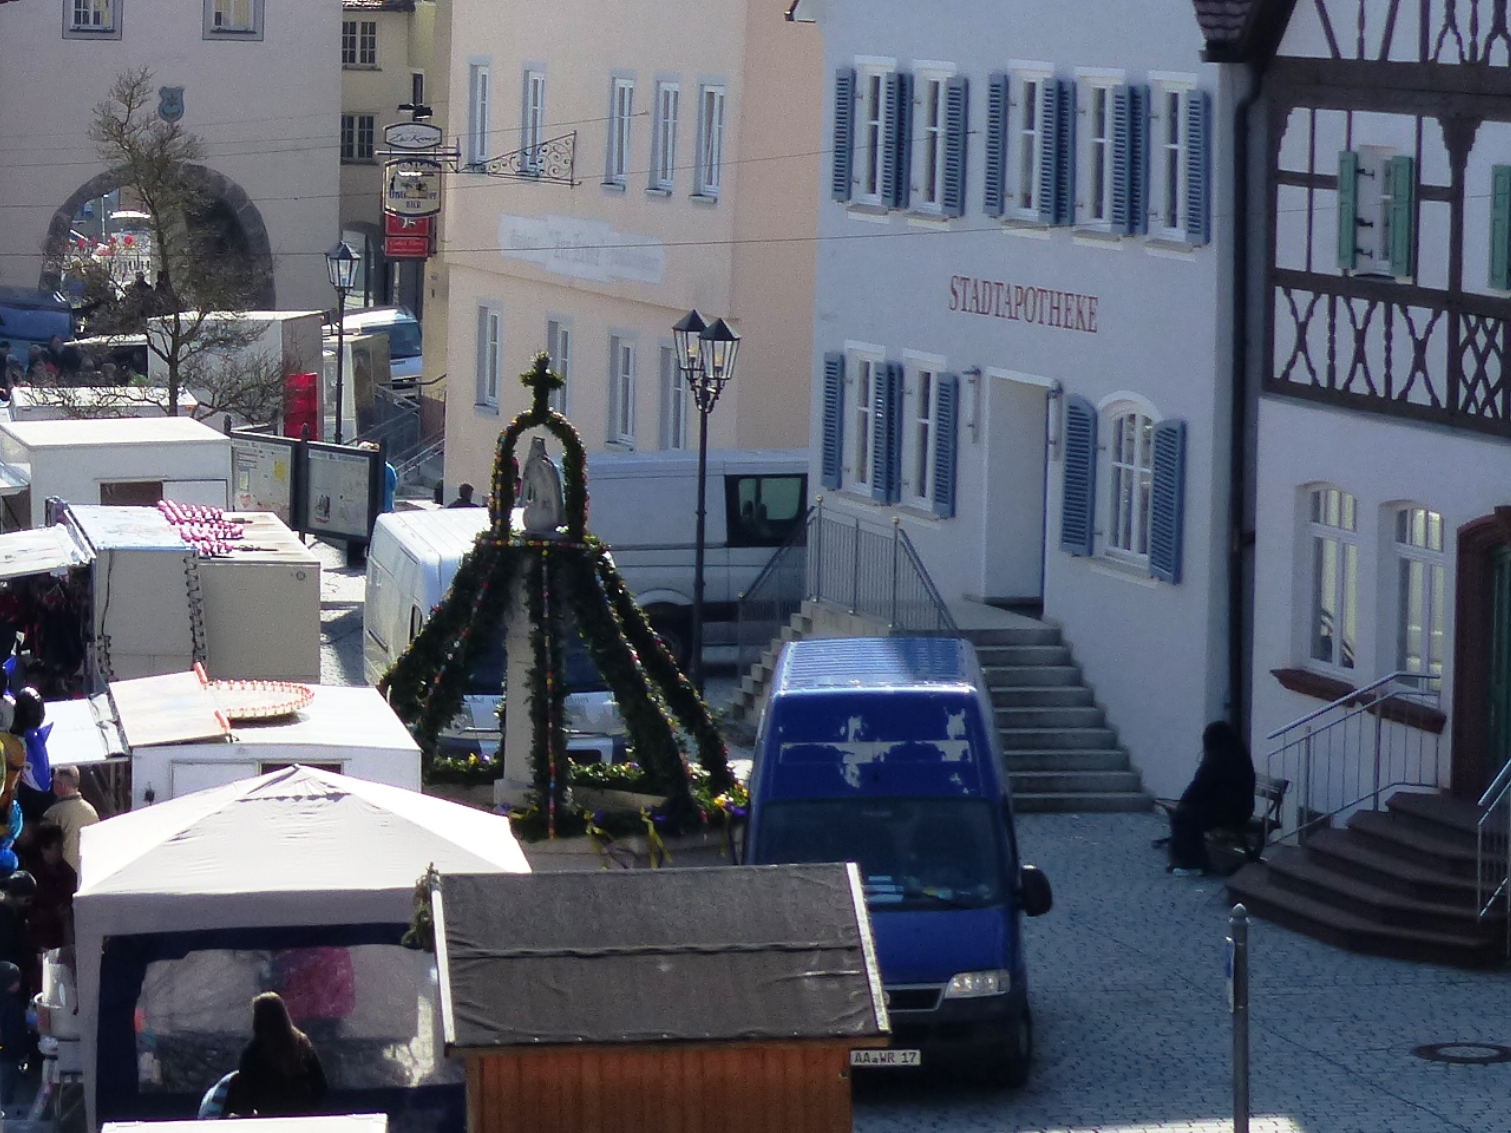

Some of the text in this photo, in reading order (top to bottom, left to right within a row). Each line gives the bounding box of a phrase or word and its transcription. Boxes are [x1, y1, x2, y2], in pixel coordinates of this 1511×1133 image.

[948, 274, 1100, 334] STADTAPOTHEKE
[854, 1052, 870, 1063] AA
[901, 1052, 917, 1063] 17
